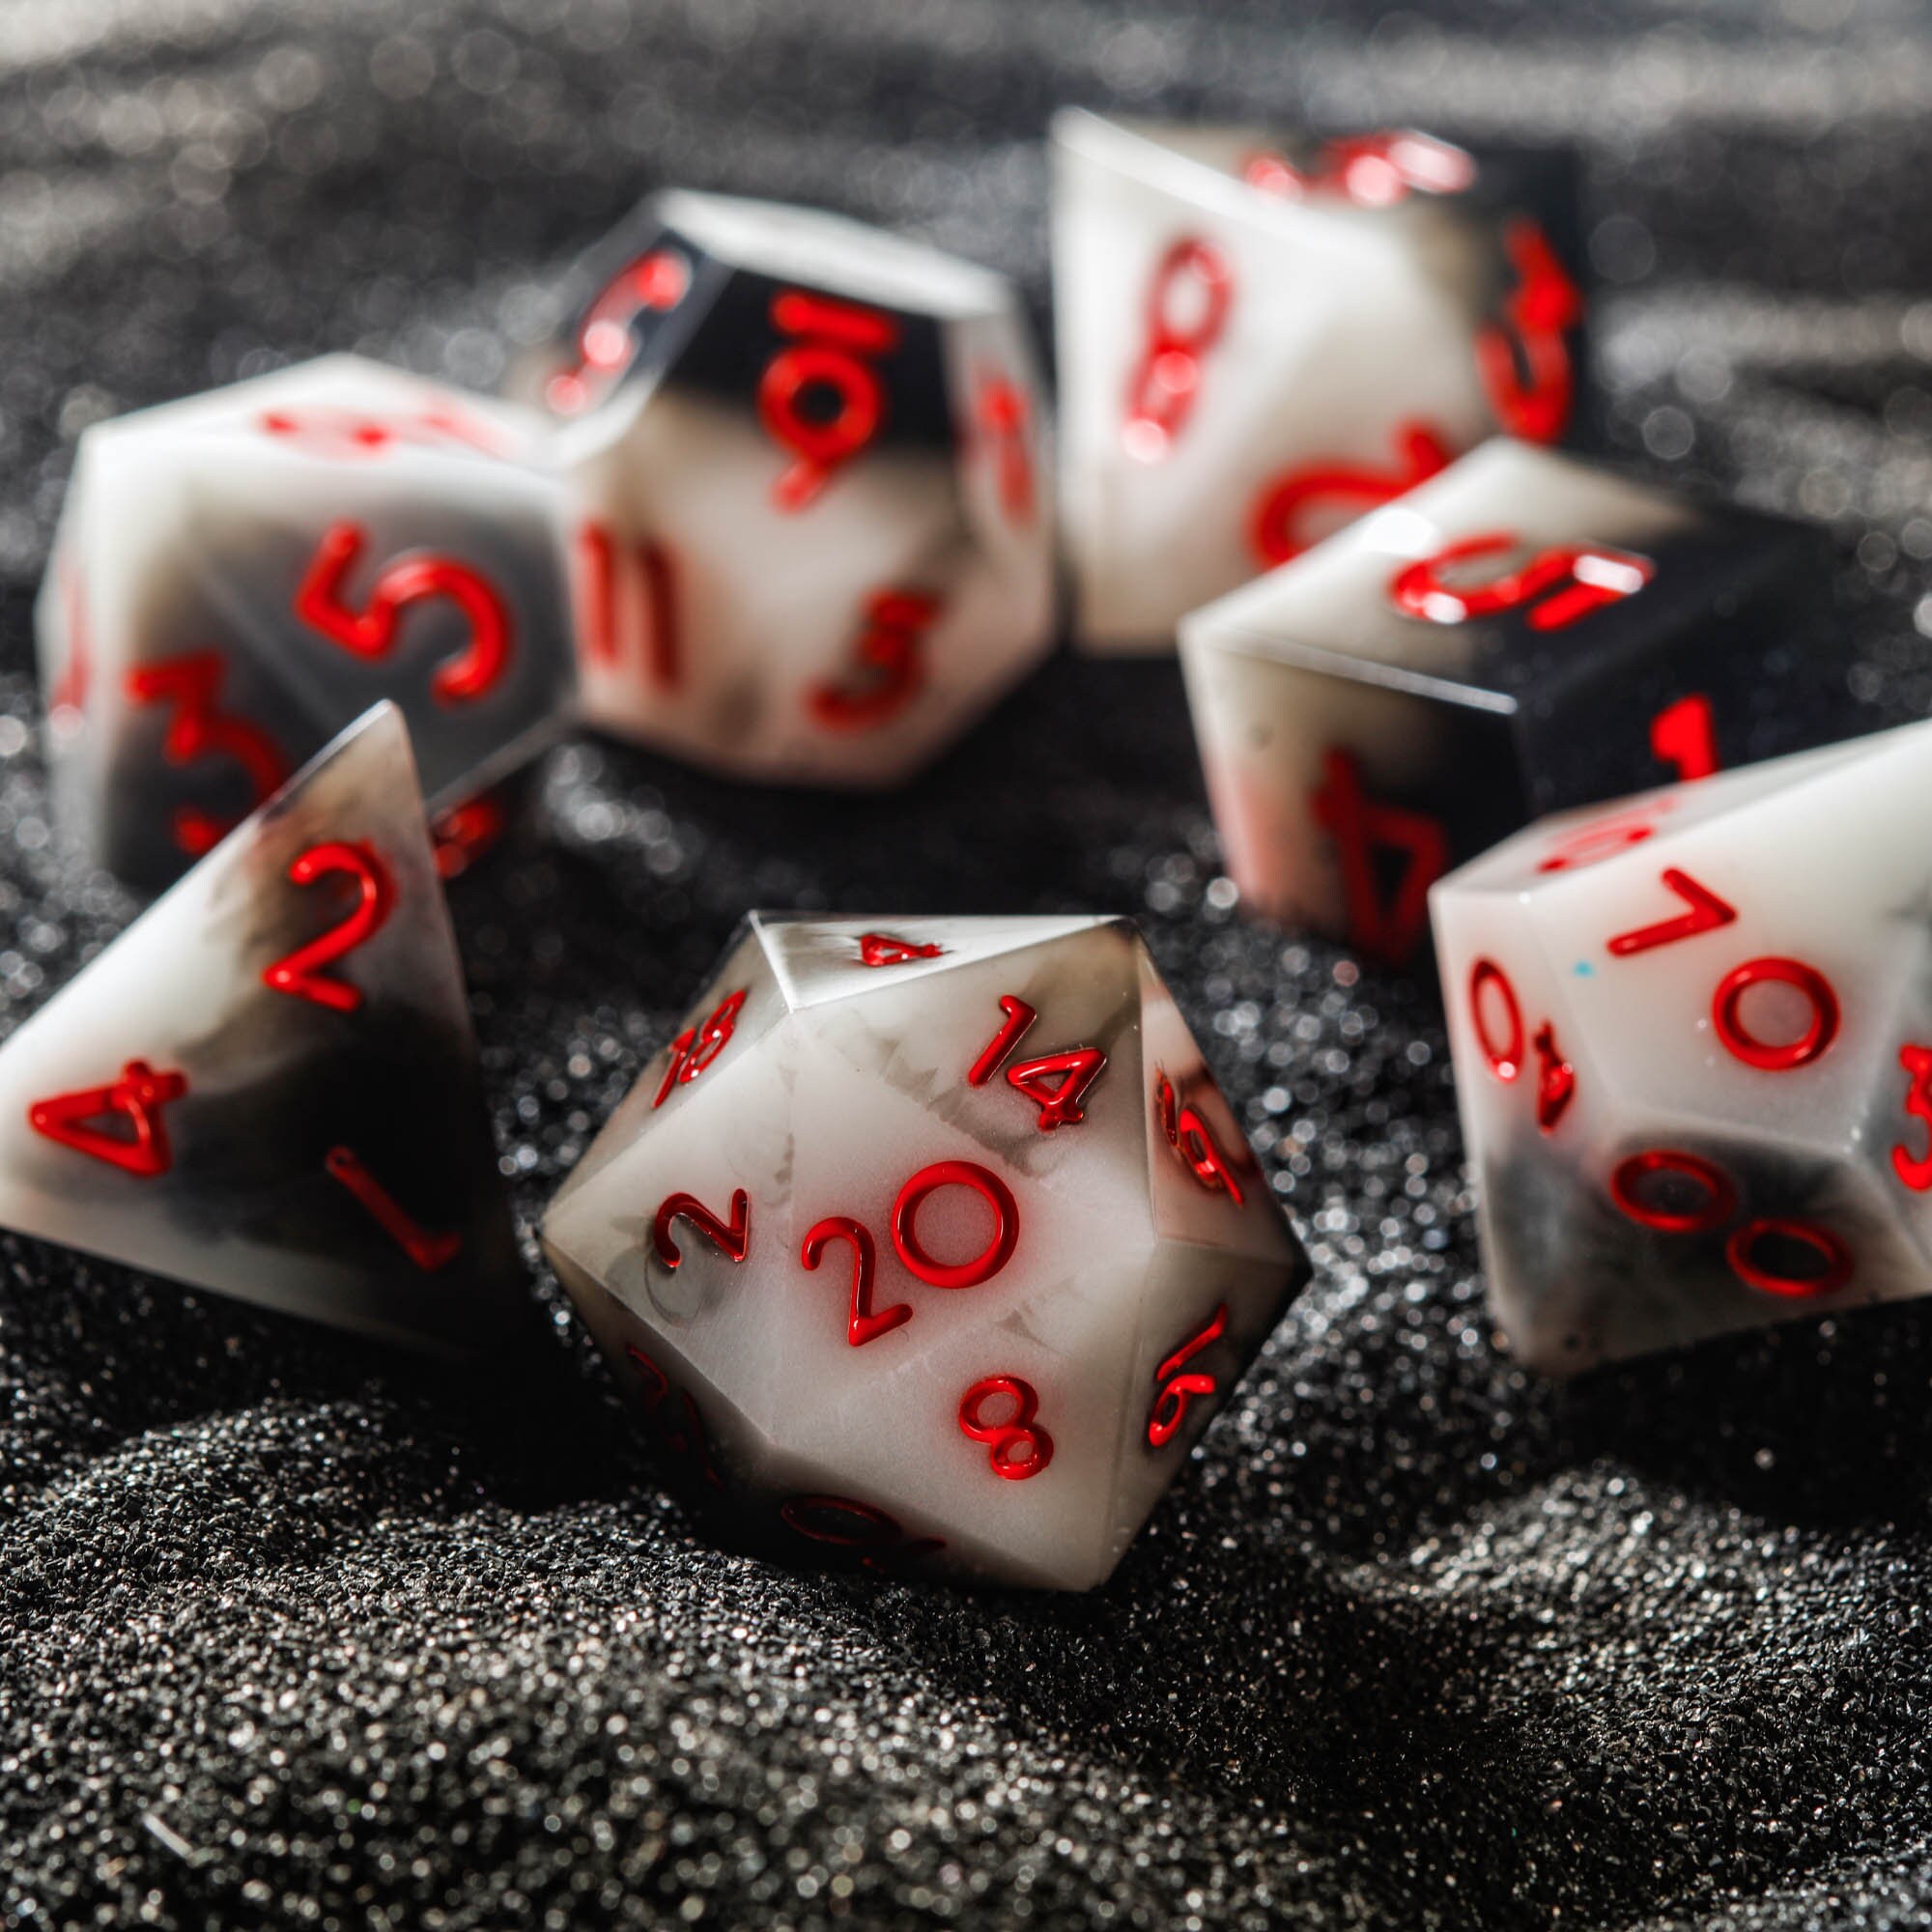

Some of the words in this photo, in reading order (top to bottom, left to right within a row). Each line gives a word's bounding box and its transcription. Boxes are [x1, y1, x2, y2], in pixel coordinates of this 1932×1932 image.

[292, 518, 512, 705] 5
[263, 841, 397, 1012] 2
[860, 932, 943, 968] 4
[1606, 867, 1841, 1072] 10
[27, 1059, 189, 1179] 4
[651, 988, 747, 1109] 18
[968, 994, 1107, 1132] 14
[653, 1187, 751, 1268] 2
[801, 1159, 1020, 1348] 20
[1610, 1149, 1854, 1299] 00
[958, 1374, 1054, 1480] 8
[1148, 1304, 1228, 1448] 16
